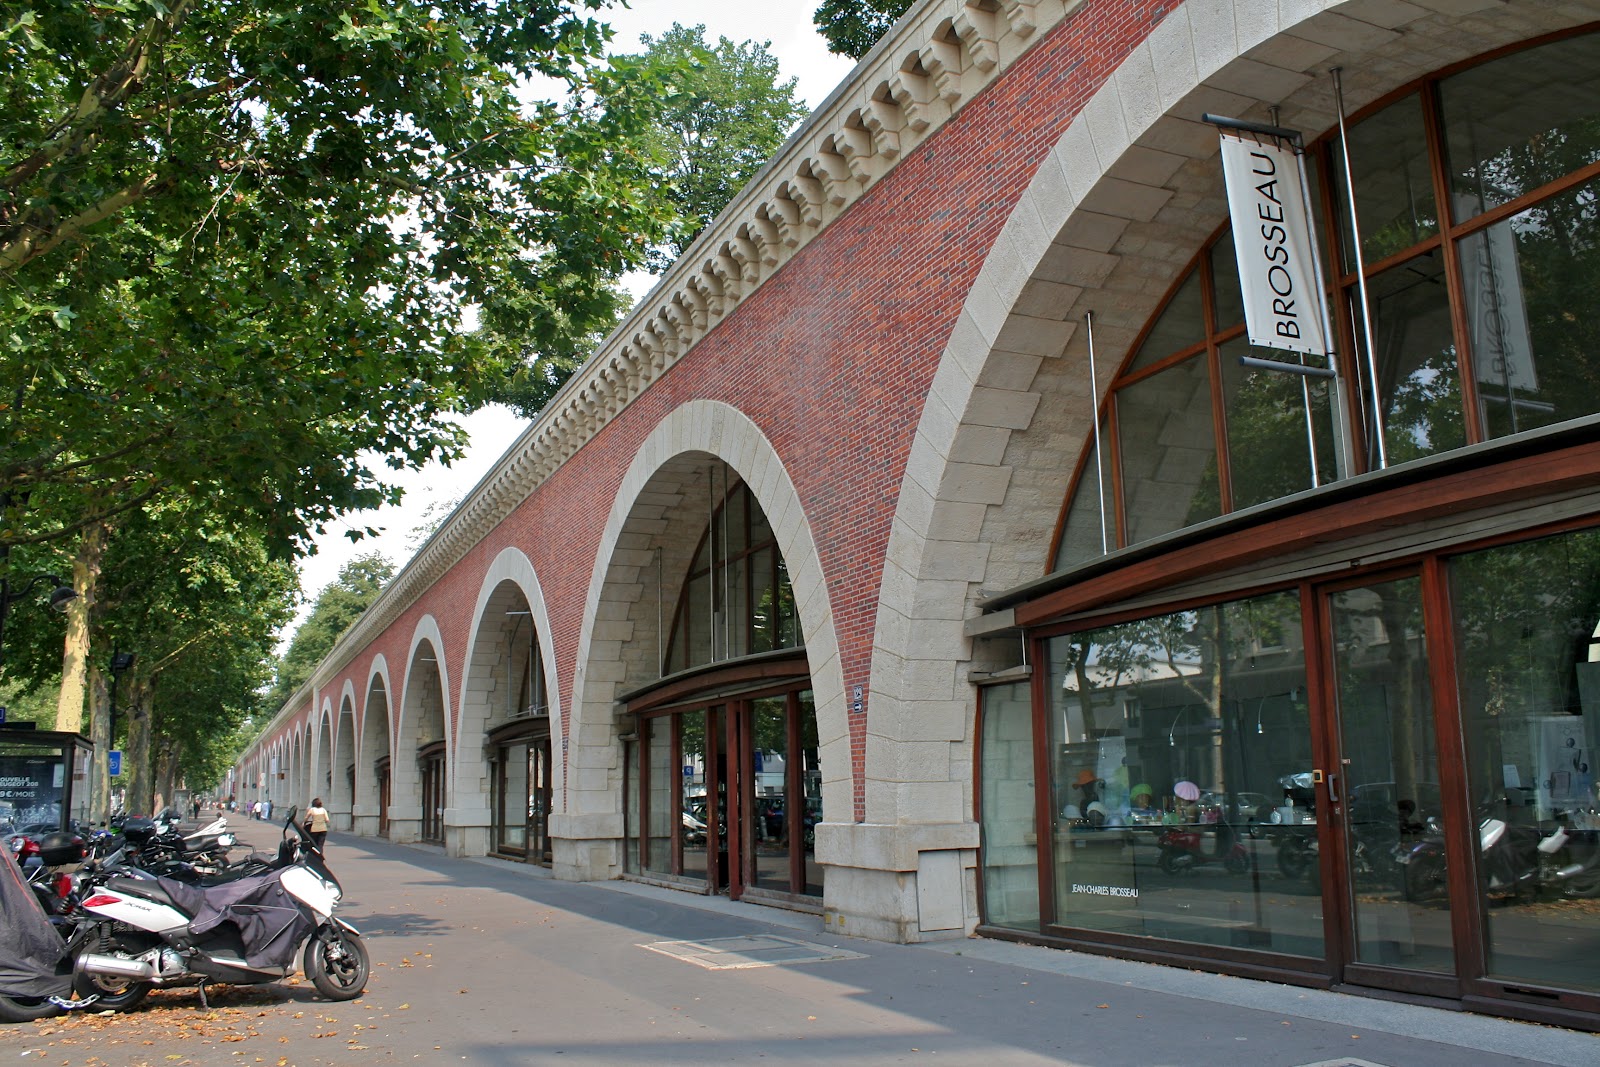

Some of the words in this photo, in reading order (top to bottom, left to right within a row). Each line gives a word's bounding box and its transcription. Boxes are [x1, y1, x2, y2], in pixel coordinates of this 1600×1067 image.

[1250, 152, 1301, 340] BROSSEAU
[1072, 884, 1109, 896] JEAN-CHARLES
[1109, 886, 1139, 898] BROSSEAU
